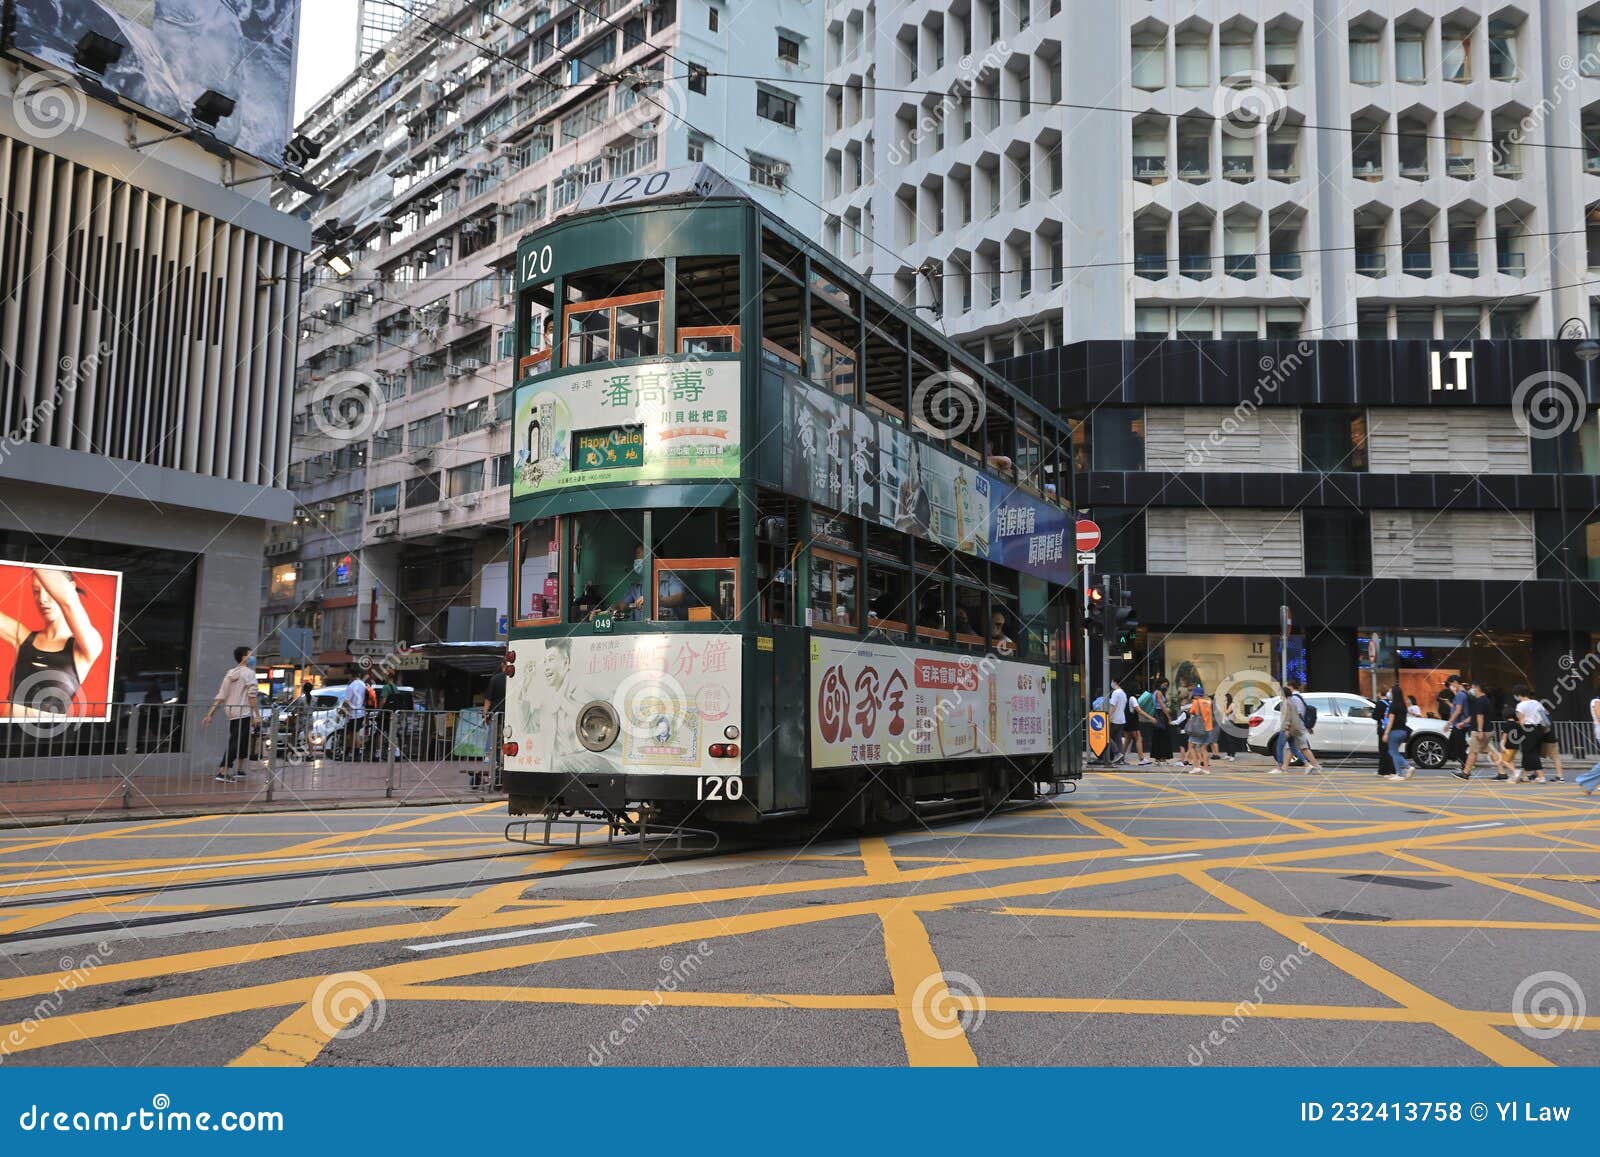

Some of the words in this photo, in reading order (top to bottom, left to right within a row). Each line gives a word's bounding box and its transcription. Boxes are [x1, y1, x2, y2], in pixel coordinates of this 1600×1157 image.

[597, 171, 671, 205] 120
[521, 245, 552, 282] 120
[1430, 350, 1473, 391] I.T
[600, 368, 705, 408] 潘高壽
[580, 436, 610, 450] Happy
[613, 431, 643, 446] Valley
[595, 619, 612, 629] 049
[696, 776, 743, 801] 120
